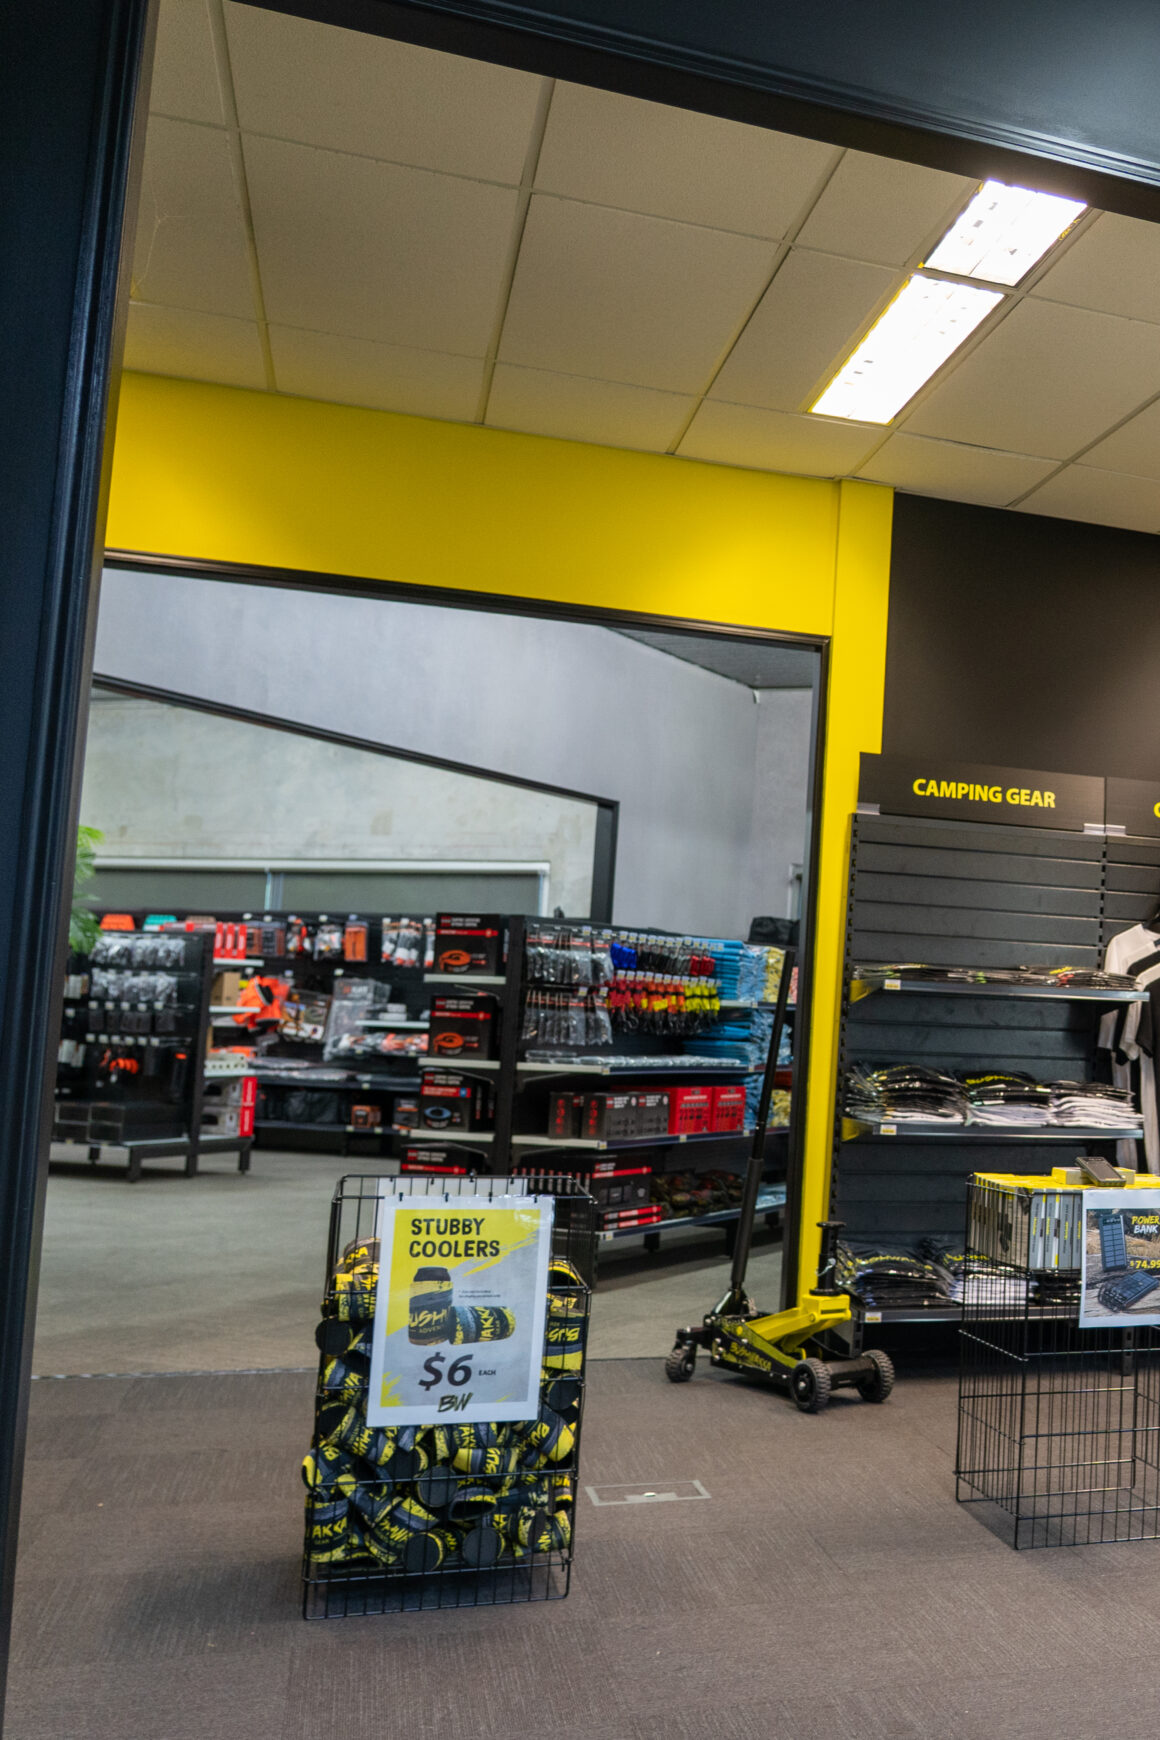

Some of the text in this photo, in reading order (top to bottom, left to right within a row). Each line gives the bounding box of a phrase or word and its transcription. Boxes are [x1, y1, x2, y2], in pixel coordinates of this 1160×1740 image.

[913, 778, 1056, 808] CAMPING GEAR
[411, 1217, 485, 1236] STUBBY
[1131, 1215, 1160, 1225] POWER
[1134, 1224, 1159, 1234] BANK
[409, 1240, 500, 1258] COOLERS
[418, 1351, 474, 1391] $6
[437, 1392, 474, 1413] BW
